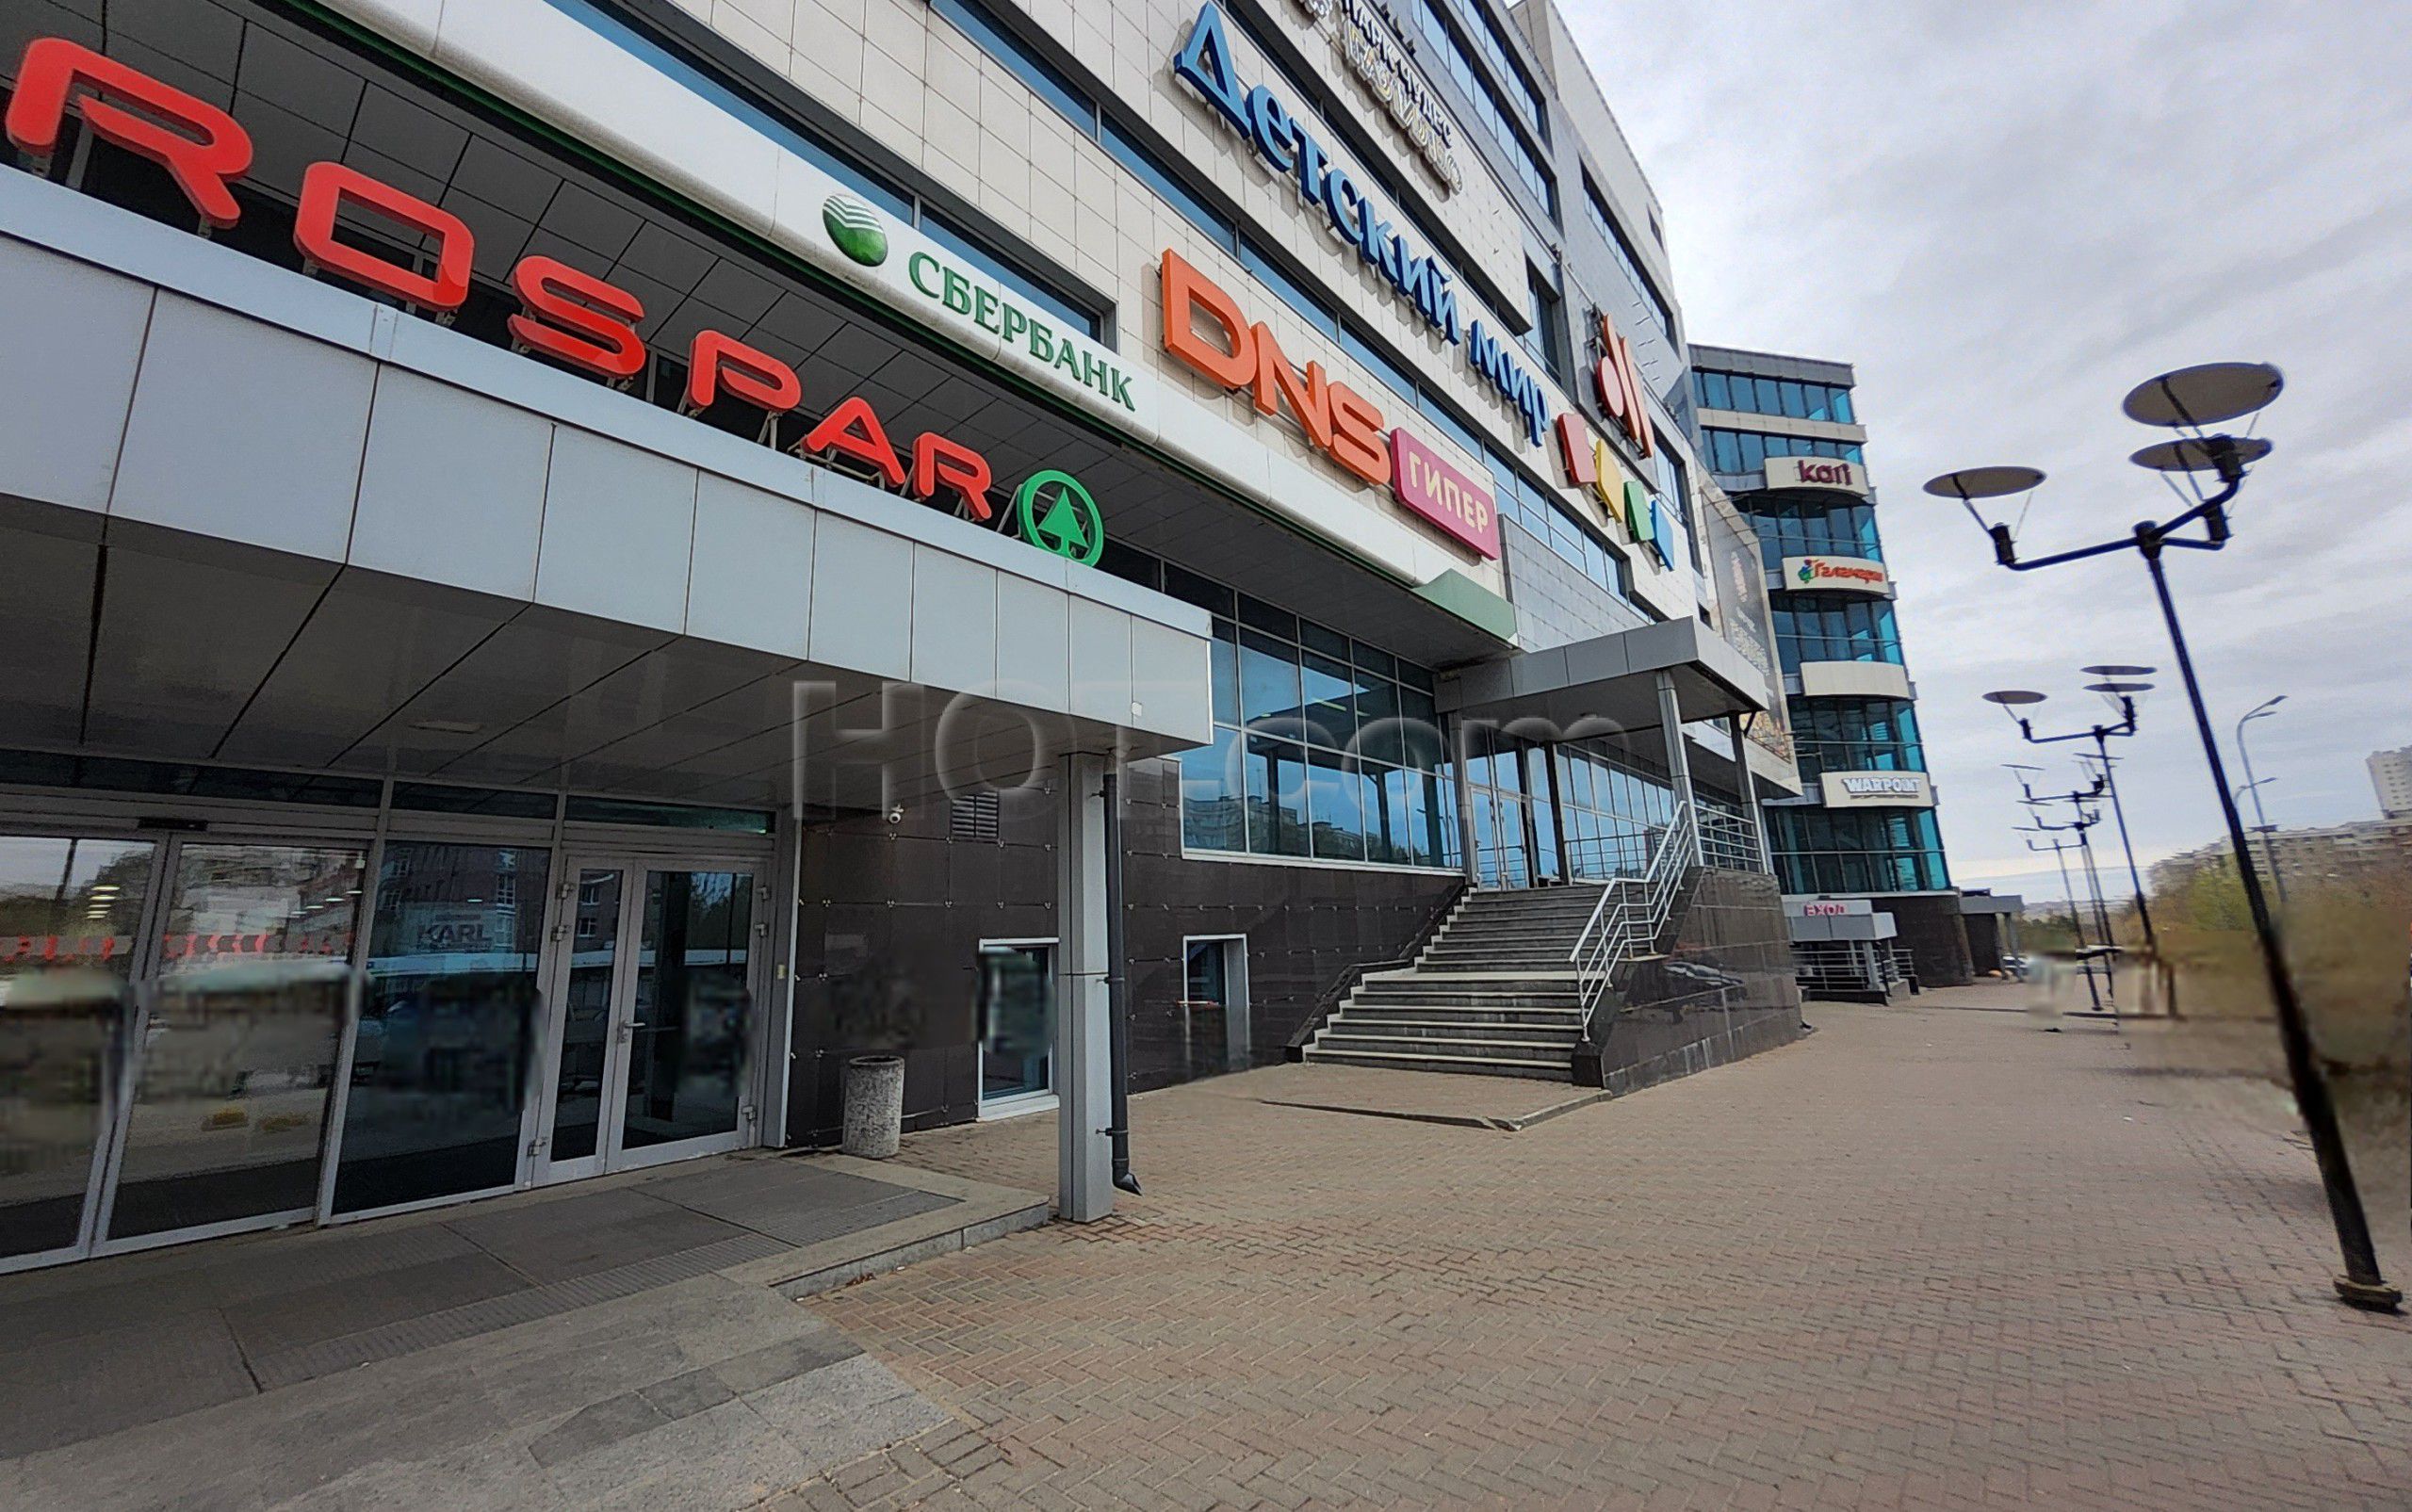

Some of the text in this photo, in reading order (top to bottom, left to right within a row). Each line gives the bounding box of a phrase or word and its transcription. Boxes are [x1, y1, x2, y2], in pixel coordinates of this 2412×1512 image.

[1175, 1, 1550, 447] Детский мир
[908, 251, 1136, 413] СБЕРБАНК
[1162, 248, 1393, 486] DNS
[1408, 449, 1489, 535] ГИПЕР
[1841, 777, 1921, 793] WARPOINT
